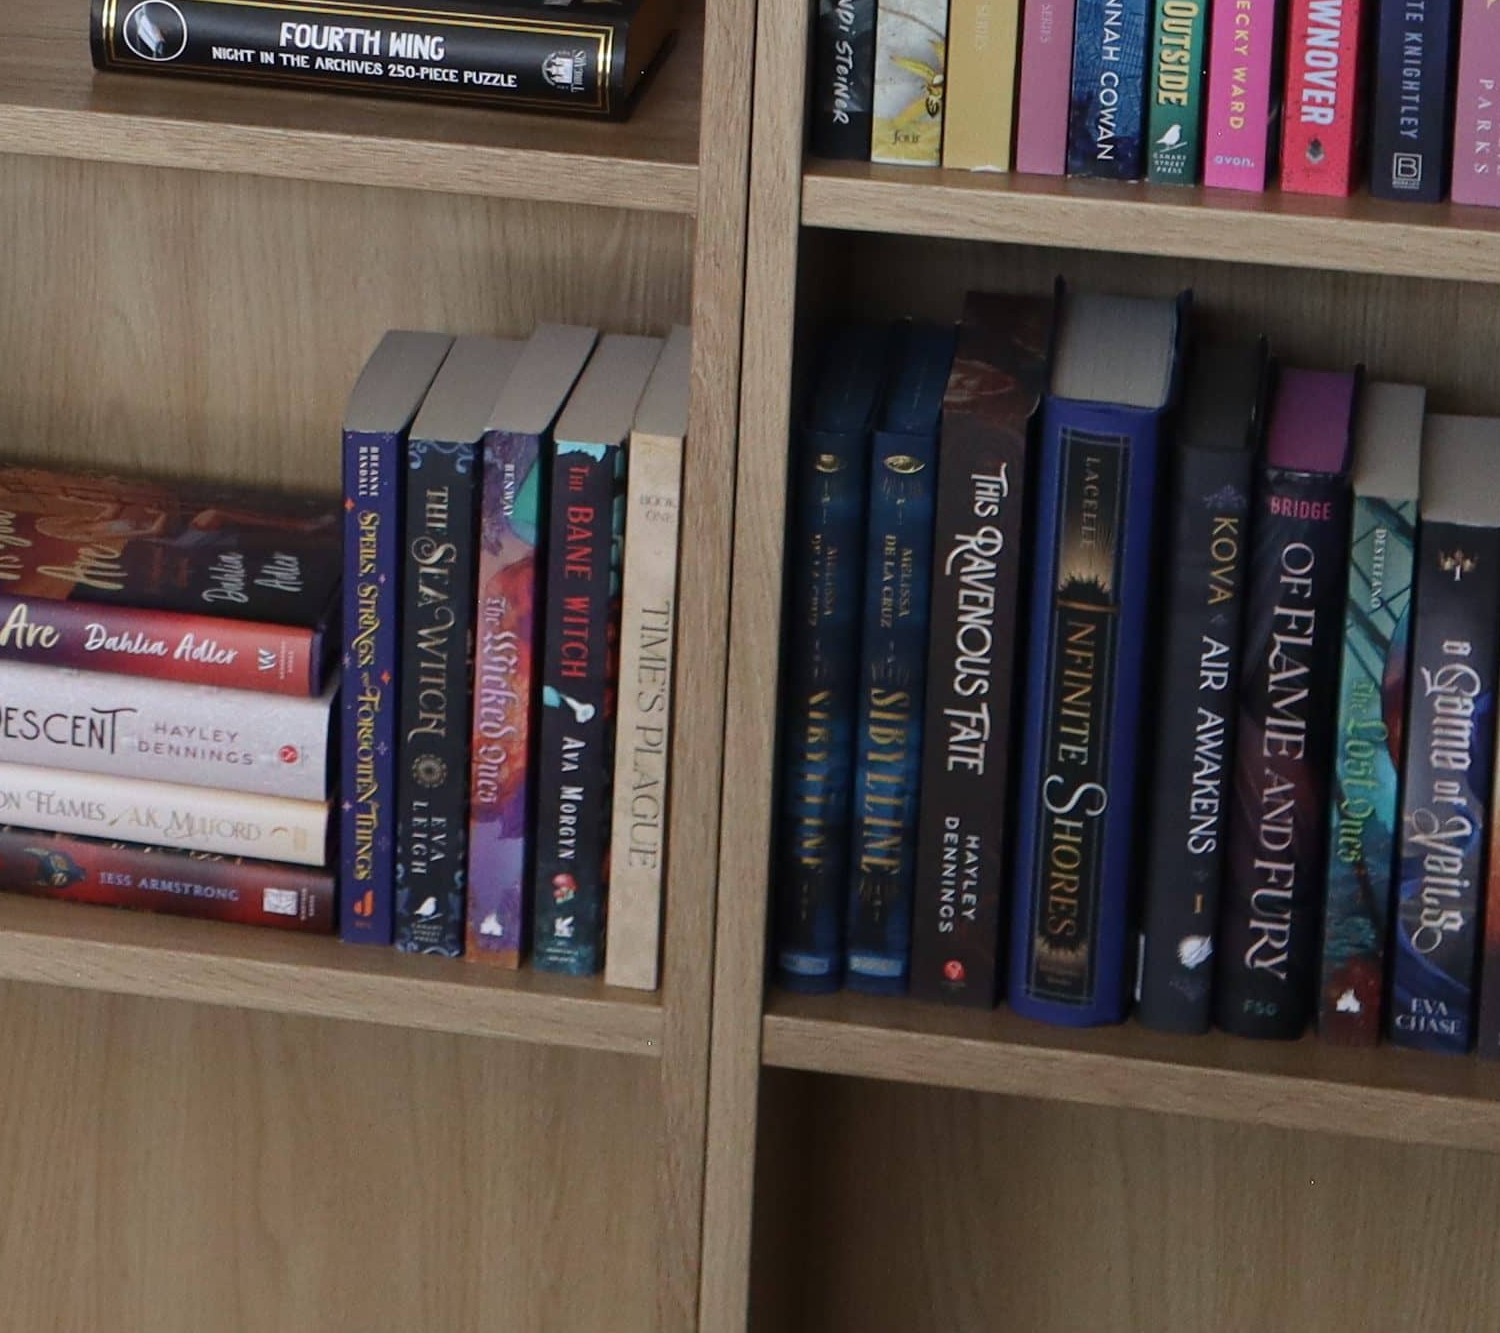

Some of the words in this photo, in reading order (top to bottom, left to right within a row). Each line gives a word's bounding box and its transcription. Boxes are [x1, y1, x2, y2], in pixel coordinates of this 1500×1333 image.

[211, 46, 256, 63] NIGHT
[260, 51, 274, 65] IN
[279, 53, 310, 69] THE
[314, 57, 384, 76] ARCHIVES
[387, 63, 459, 83] 250-PIECE
[463, 70, 518, 88] PUZZLE
[280, 22, 380, 57] FOURTH
[389, 32, 445, 62] WING
[1278, 542, 1316, 599] OF
[1265, 605, 1316, 761] FLAME
[1264, 766, 1299, 865] AND
[1249, 858, 1291, 984] FURY
